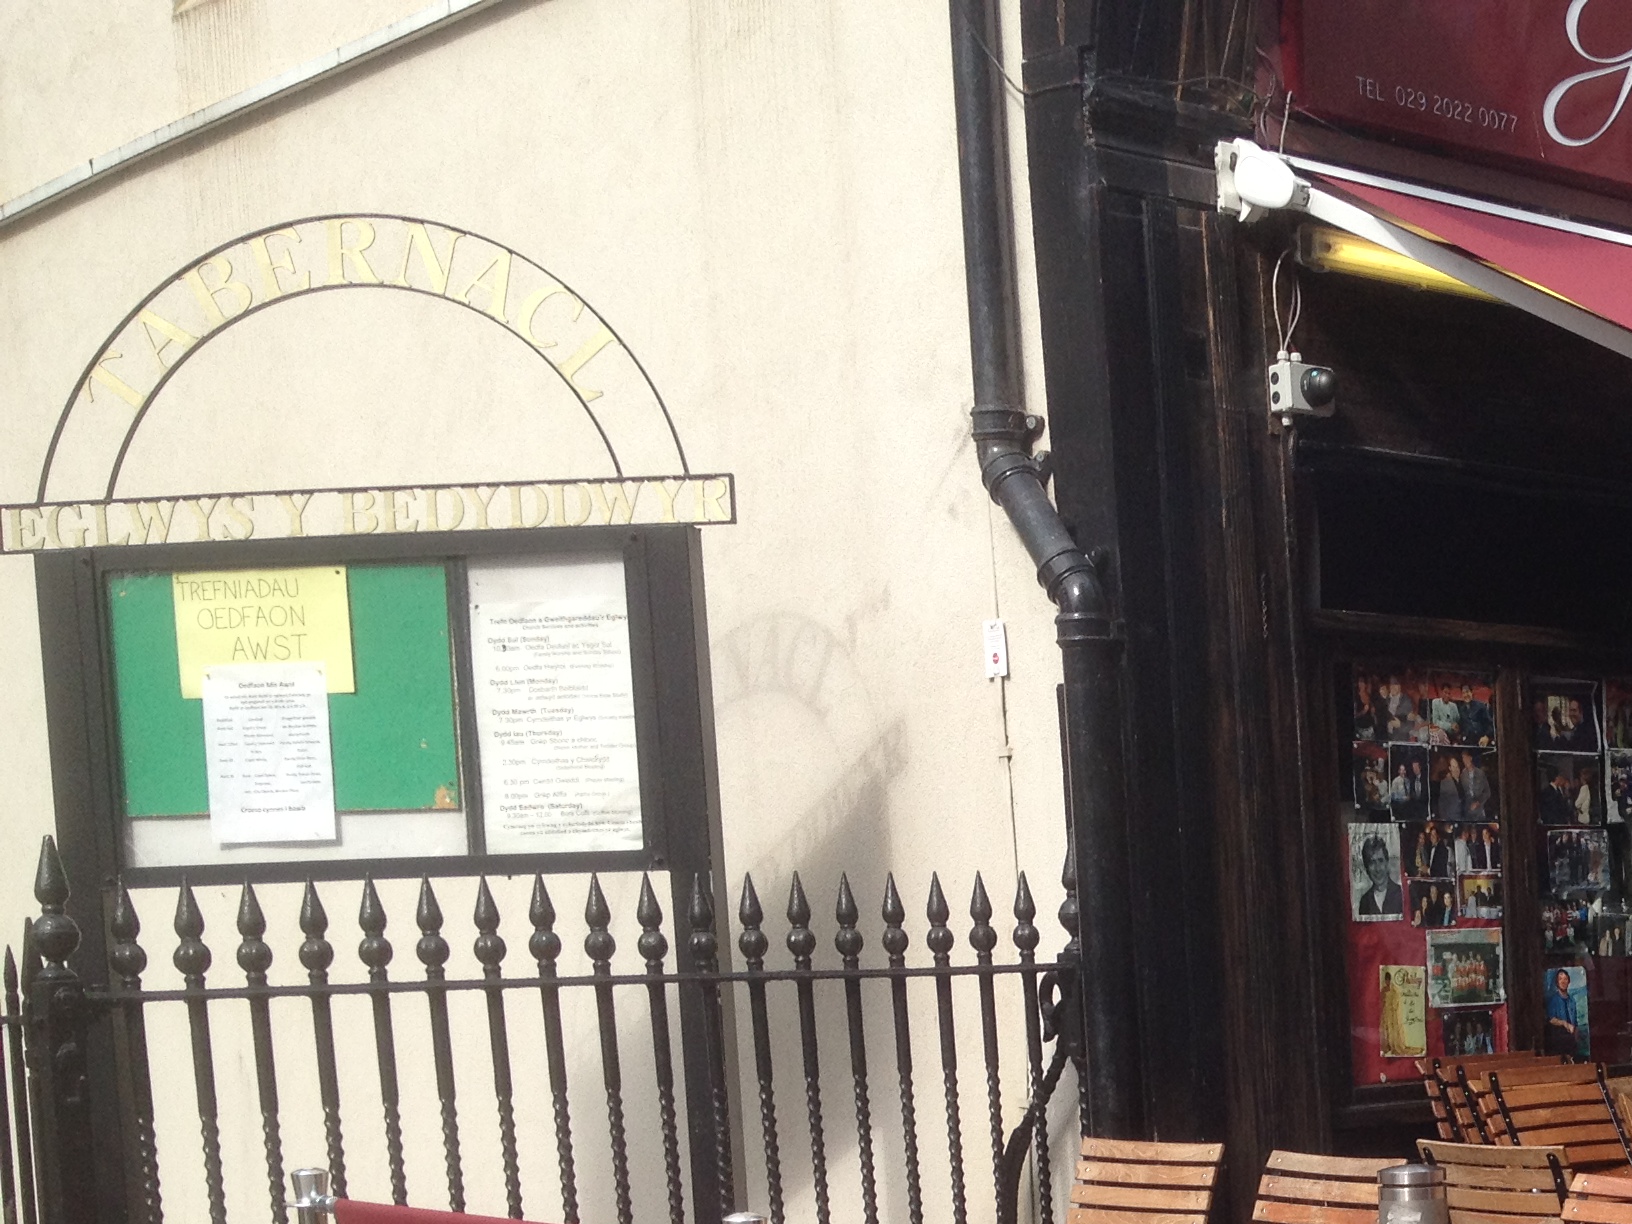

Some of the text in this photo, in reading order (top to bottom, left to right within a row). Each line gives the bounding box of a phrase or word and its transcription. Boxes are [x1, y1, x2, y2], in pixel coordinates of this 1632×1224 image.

[1355, 75, 1518, 133] TEL 029 2022 0077
[88, 218, 623, 410] TABERNACL
[9, 475, 729, 550] EGLWYS Y BEDYDDWYR
[178, 578, 299, 601] TREFNIADAU
[197, 605, 306, 630] OEDFAON
[232, 633, 308, 661] AWST
